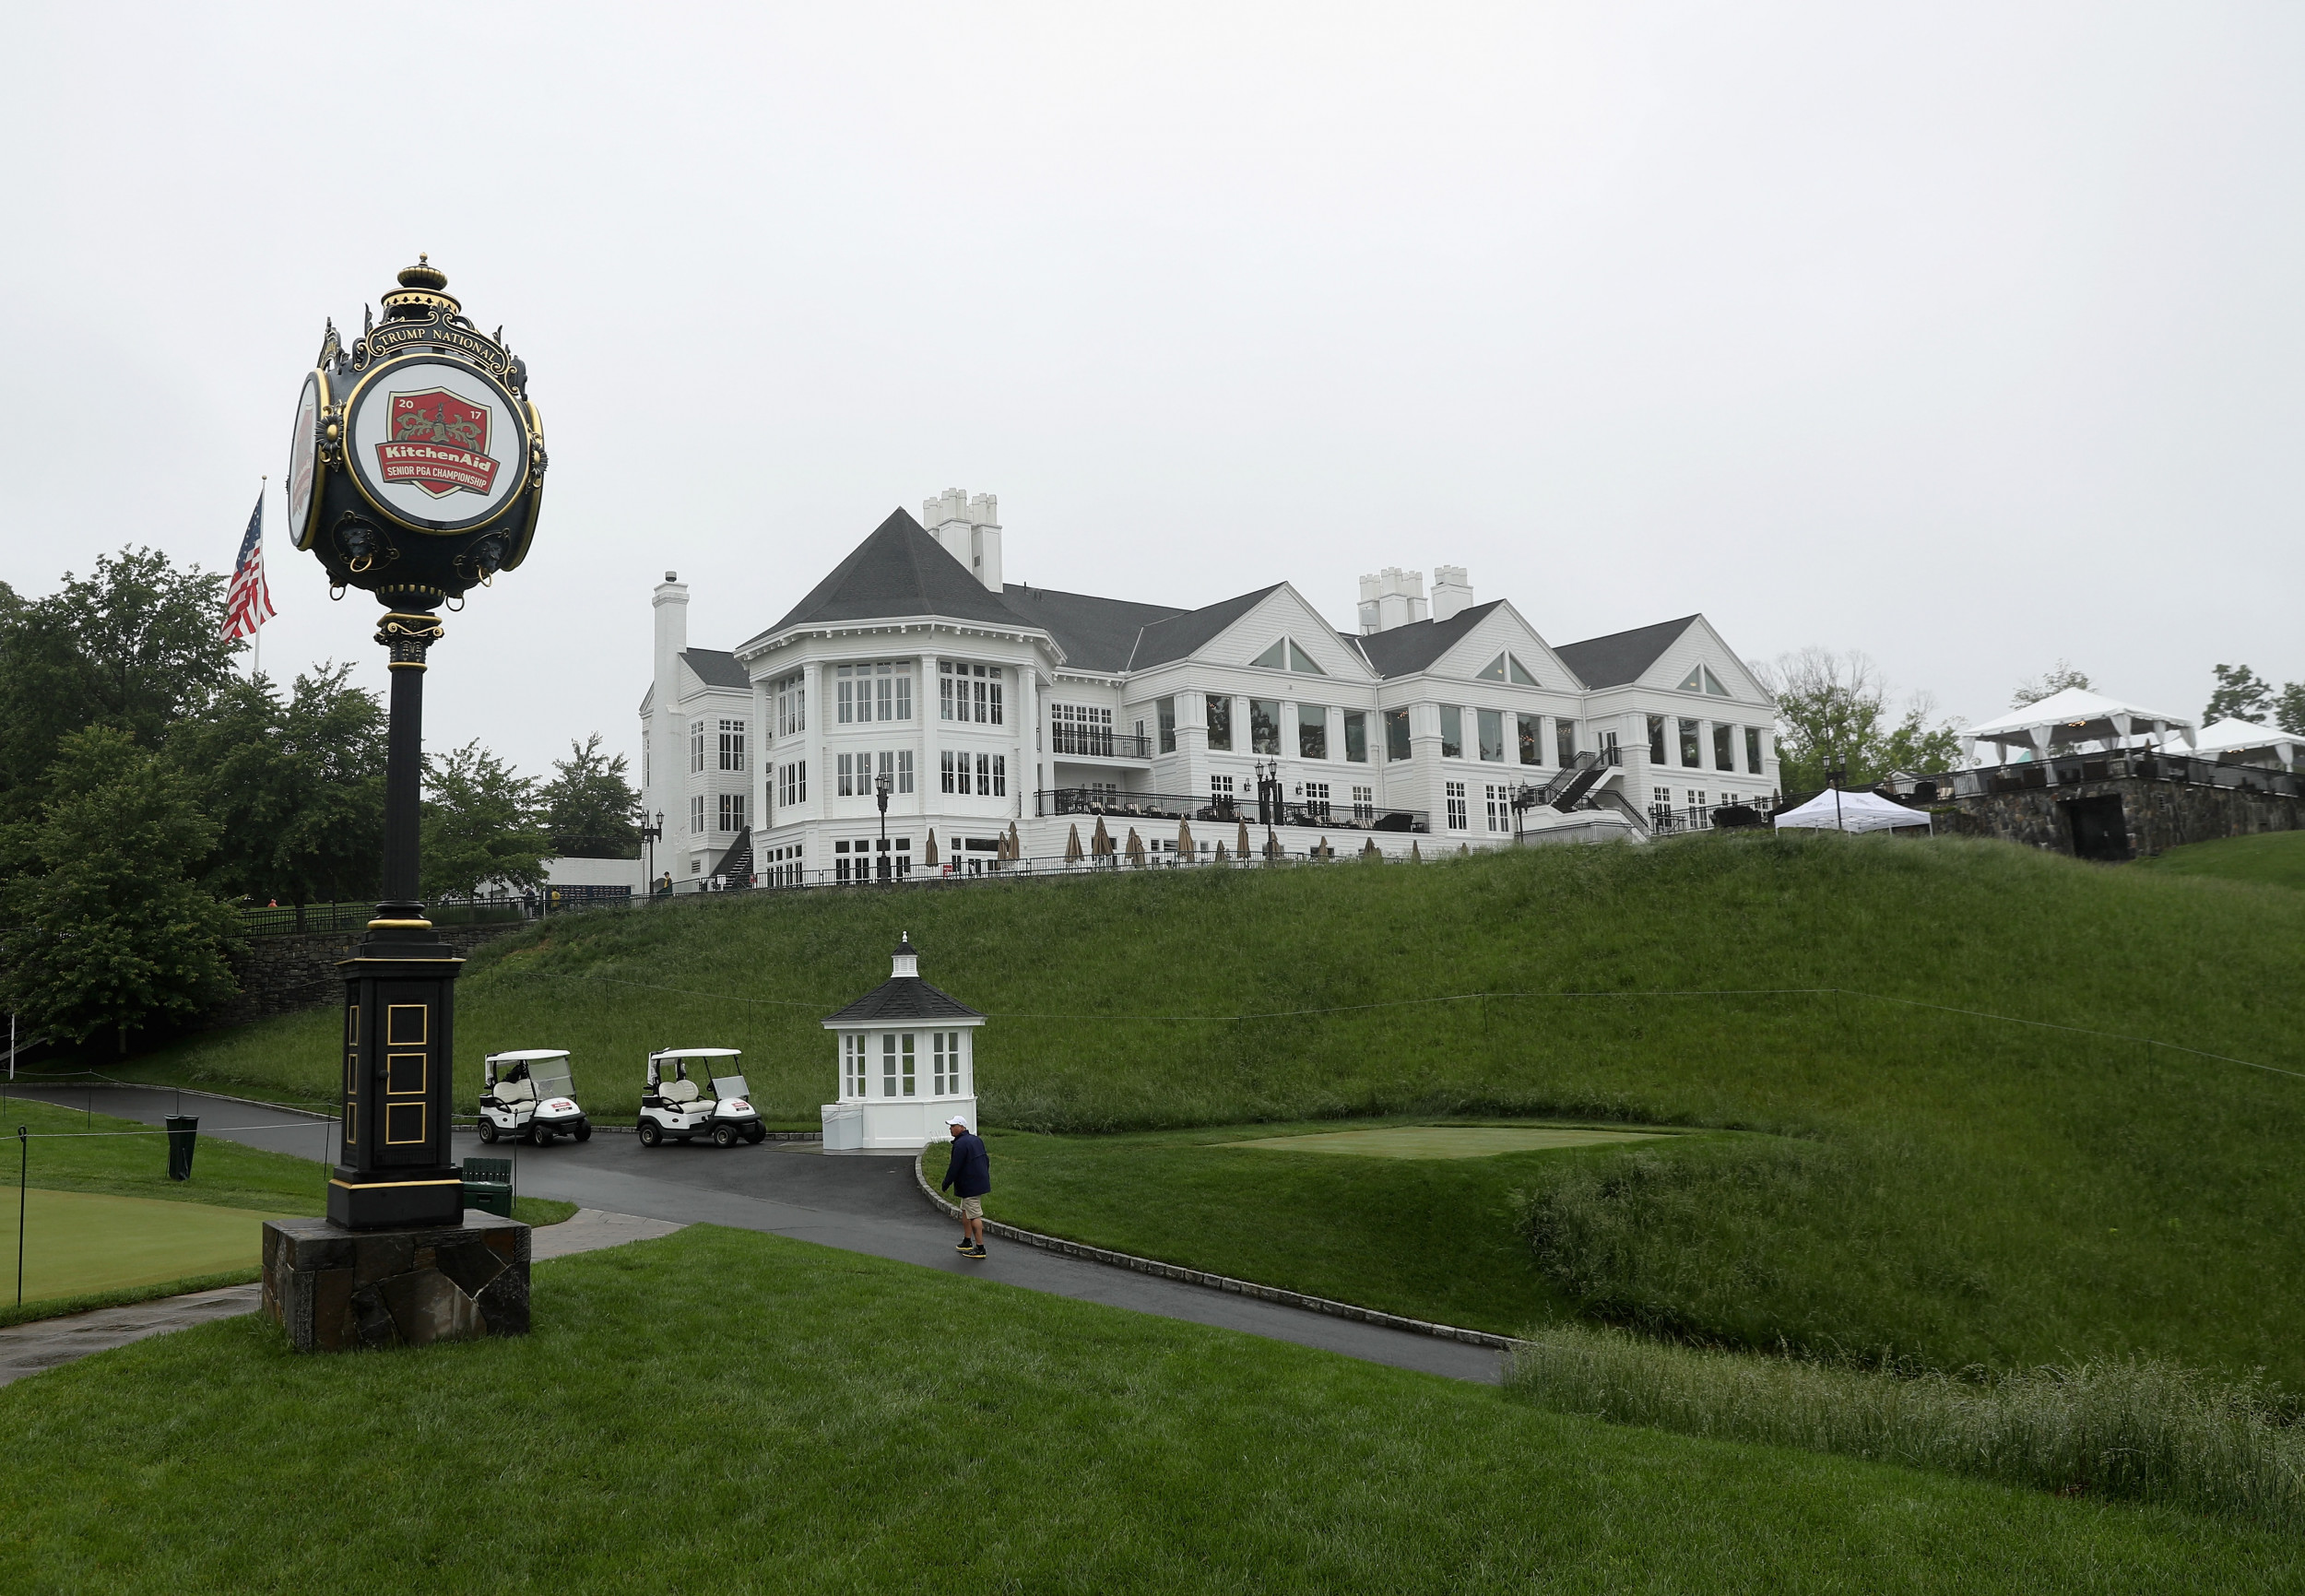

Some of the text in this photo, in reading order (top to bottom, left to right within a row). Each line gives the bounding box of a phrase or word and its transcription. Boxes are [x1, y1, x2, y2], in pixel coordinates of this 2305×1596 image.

[379, 328, 496, 362] TRUMP NATIONAL
[398, 399, 482, 420] 20 17
[385, 446, 491, 472] KitchenAid
[387, 466, 487, 488] SENIOR PGA CHAMPIONSHIP
